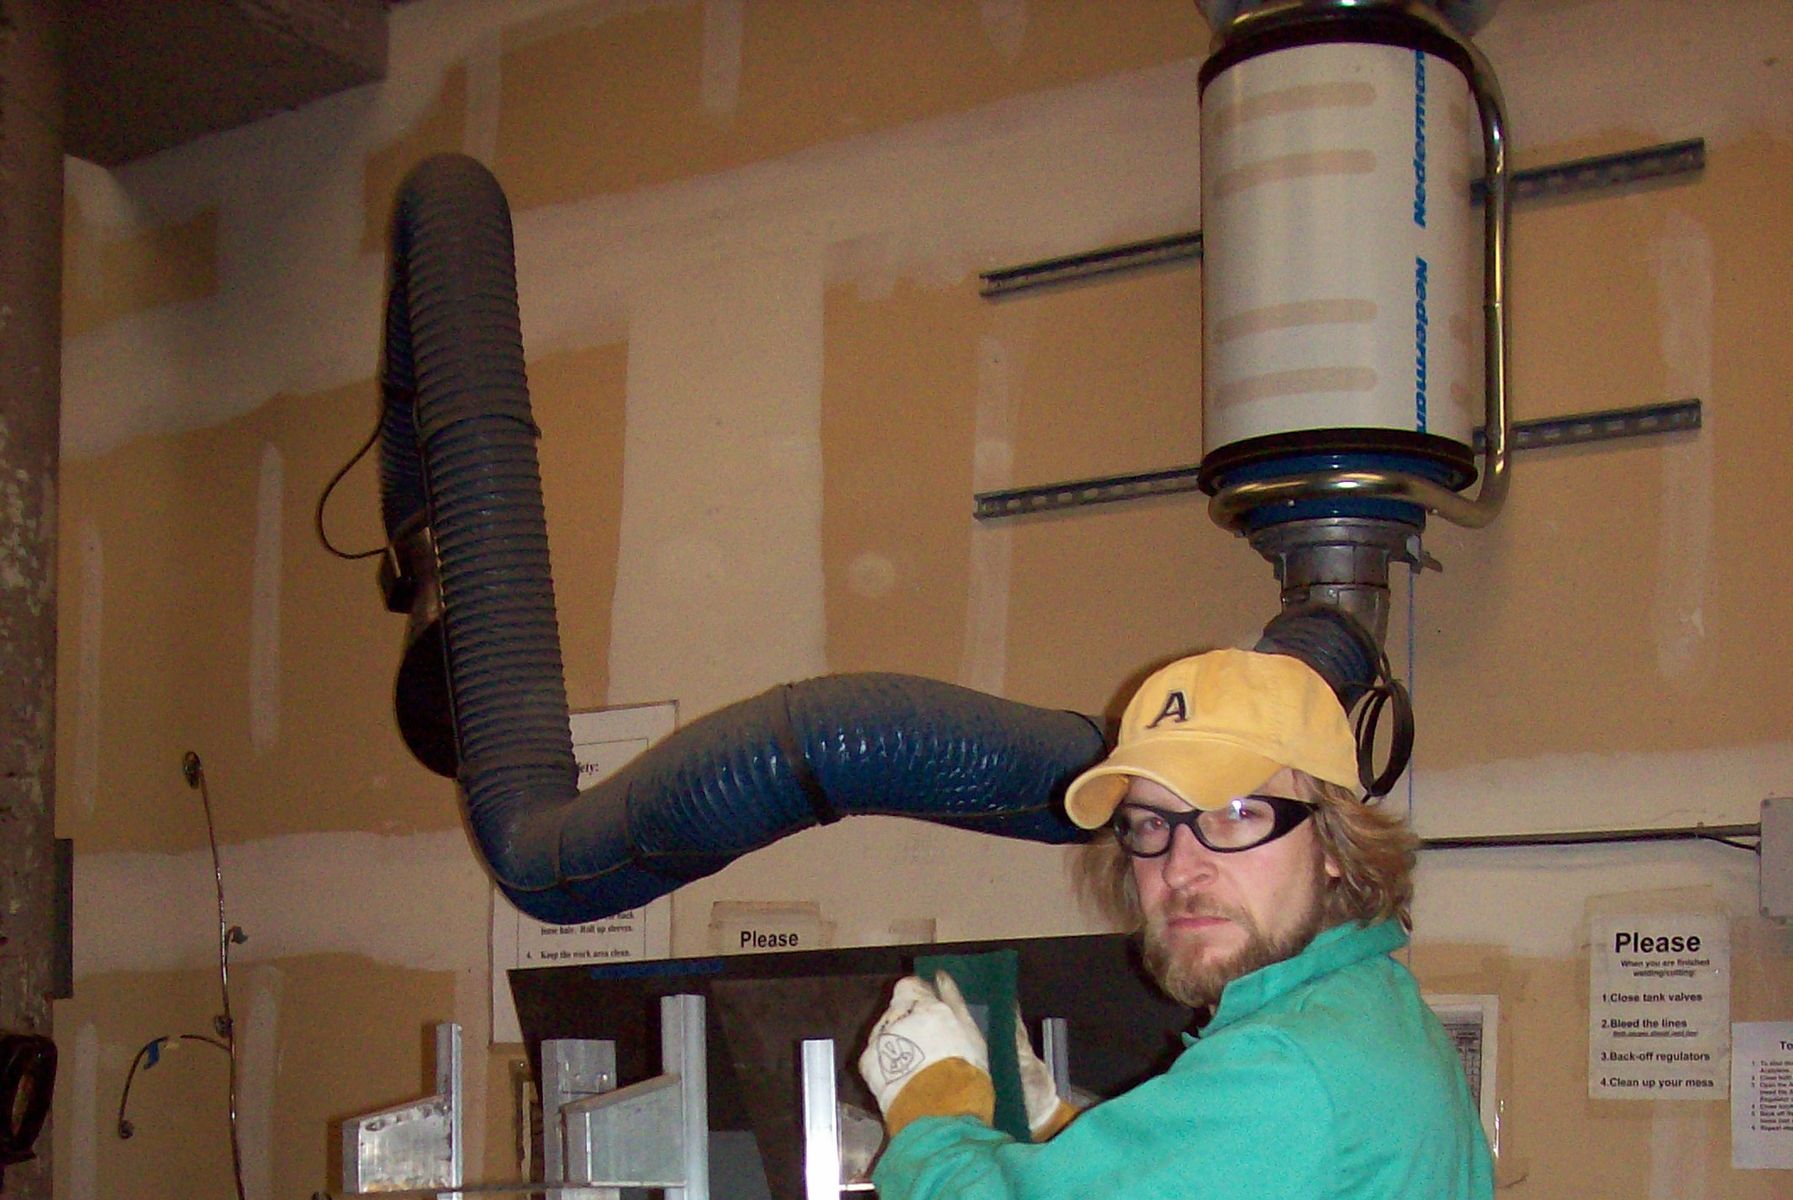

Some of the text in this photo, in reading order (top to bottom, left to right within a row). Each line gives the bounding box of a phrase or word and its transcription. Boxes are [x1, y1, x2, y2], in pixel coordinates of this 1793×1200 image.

[1145, 690, 1187, 729] A
[740, 930, 799, 948] Please
[1615, 932, 1702, 953] Please
[1621, 960, 1644, 968] When
[1646, 960, 1661, 968] you
[1643, 993, 1665, 1002] tank
[1668, 992, 1703, 1002] valves
[1642, 1018, 1660, 1028] the
[1661, 1017, 1688, 1028] lines
[1656, 1051, 1711, 1063] regulators
[1642, 1079, 1656, 1088] up
[1658, 1079, 1682, 1088] your
[1685, 1079, 1714, 1088] mess
